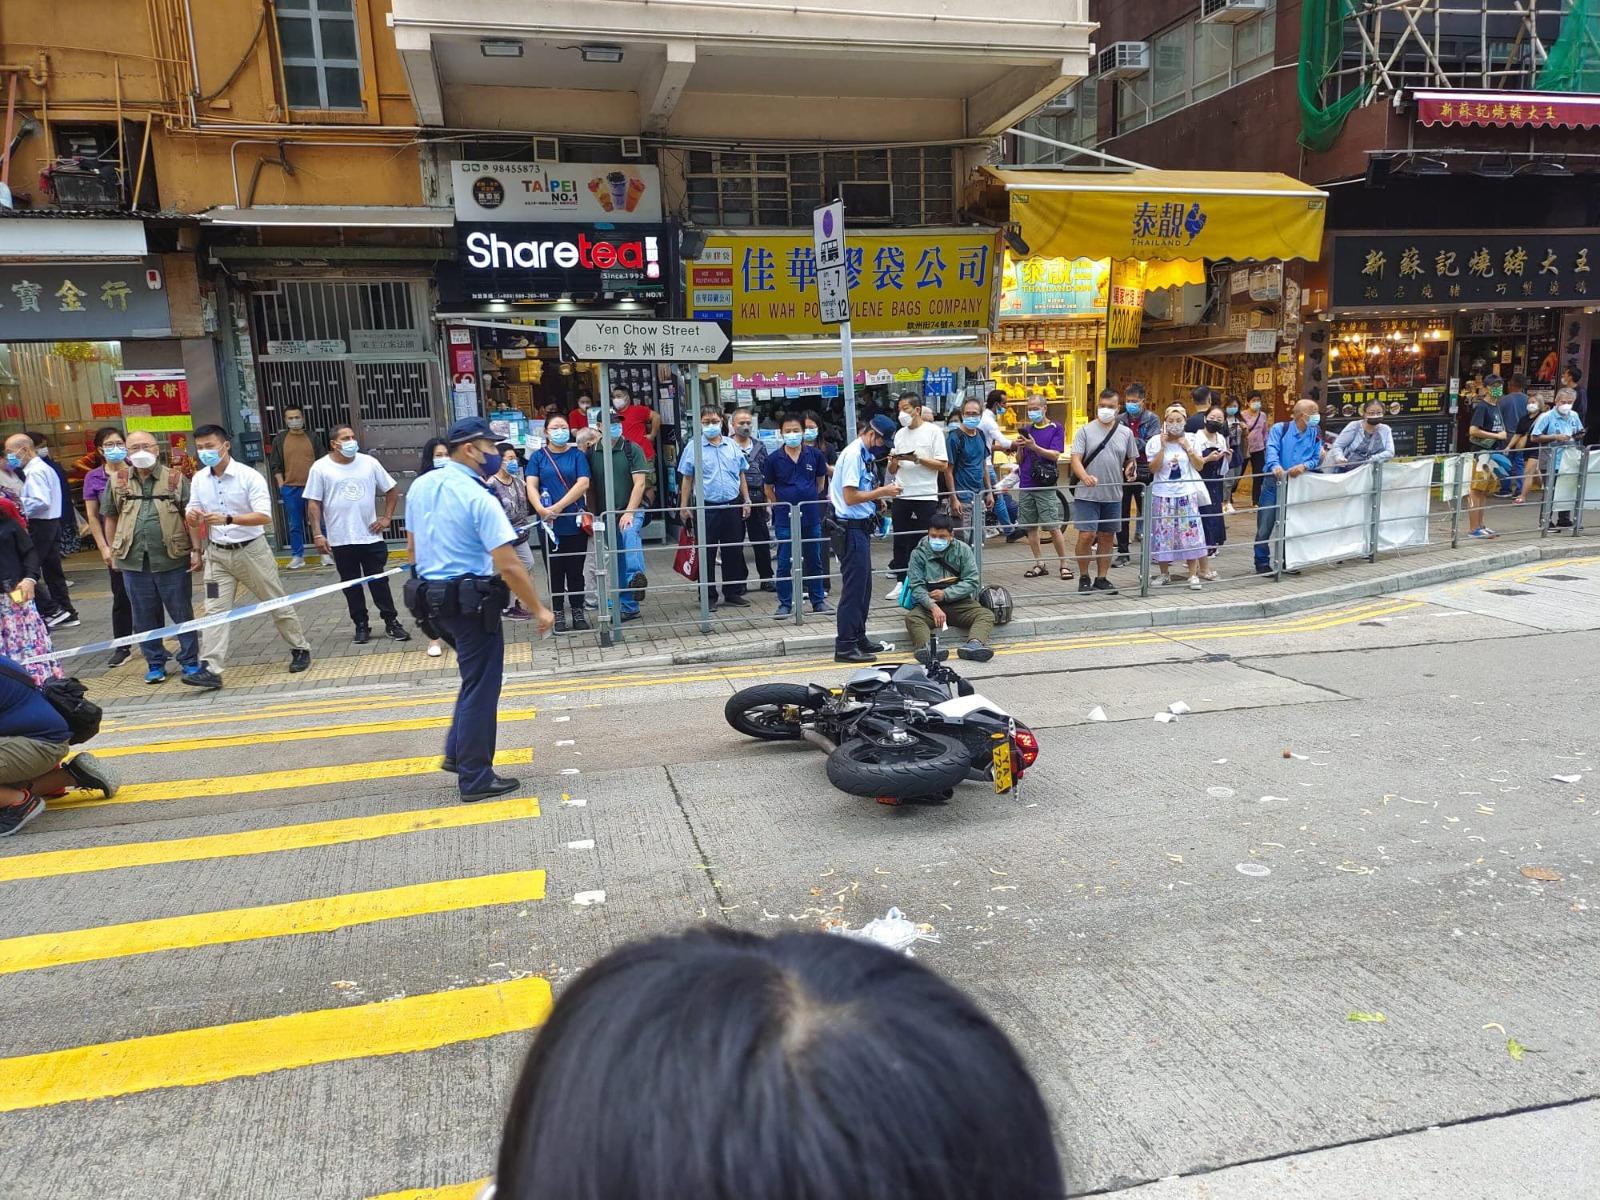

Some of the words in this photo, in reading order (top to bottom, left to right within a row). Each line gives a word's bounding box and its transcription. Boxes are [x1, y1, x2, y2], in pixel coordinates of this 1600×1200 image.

[492, 164, 541, 174] 98455873
[521, 173, 577, 193] TAIPEI
[551, 193, 578, 202] NO.1
[1131, 238, 1181, 247] THAILAND
[835, 269, 840, 287] 7
[0, 280, 133, 312] 寶金行
[741, 302, 760, 319] KAI
[769, 302, 796, 319] WAH
[891, 300, 921, 316] BAGS
[928, 298, 983, 316] COMPANY
[838, 298, 848, 317] 12
[595, 323, 619, 335] Yen
[623, 324, 657, 335] Chow
[662, 325, 700, 336] Street
[623, 342, 674, 357] 欽州街
[680, 345, 716, 354] 74A-68
[124, 383, 179, 399] 人民幣
